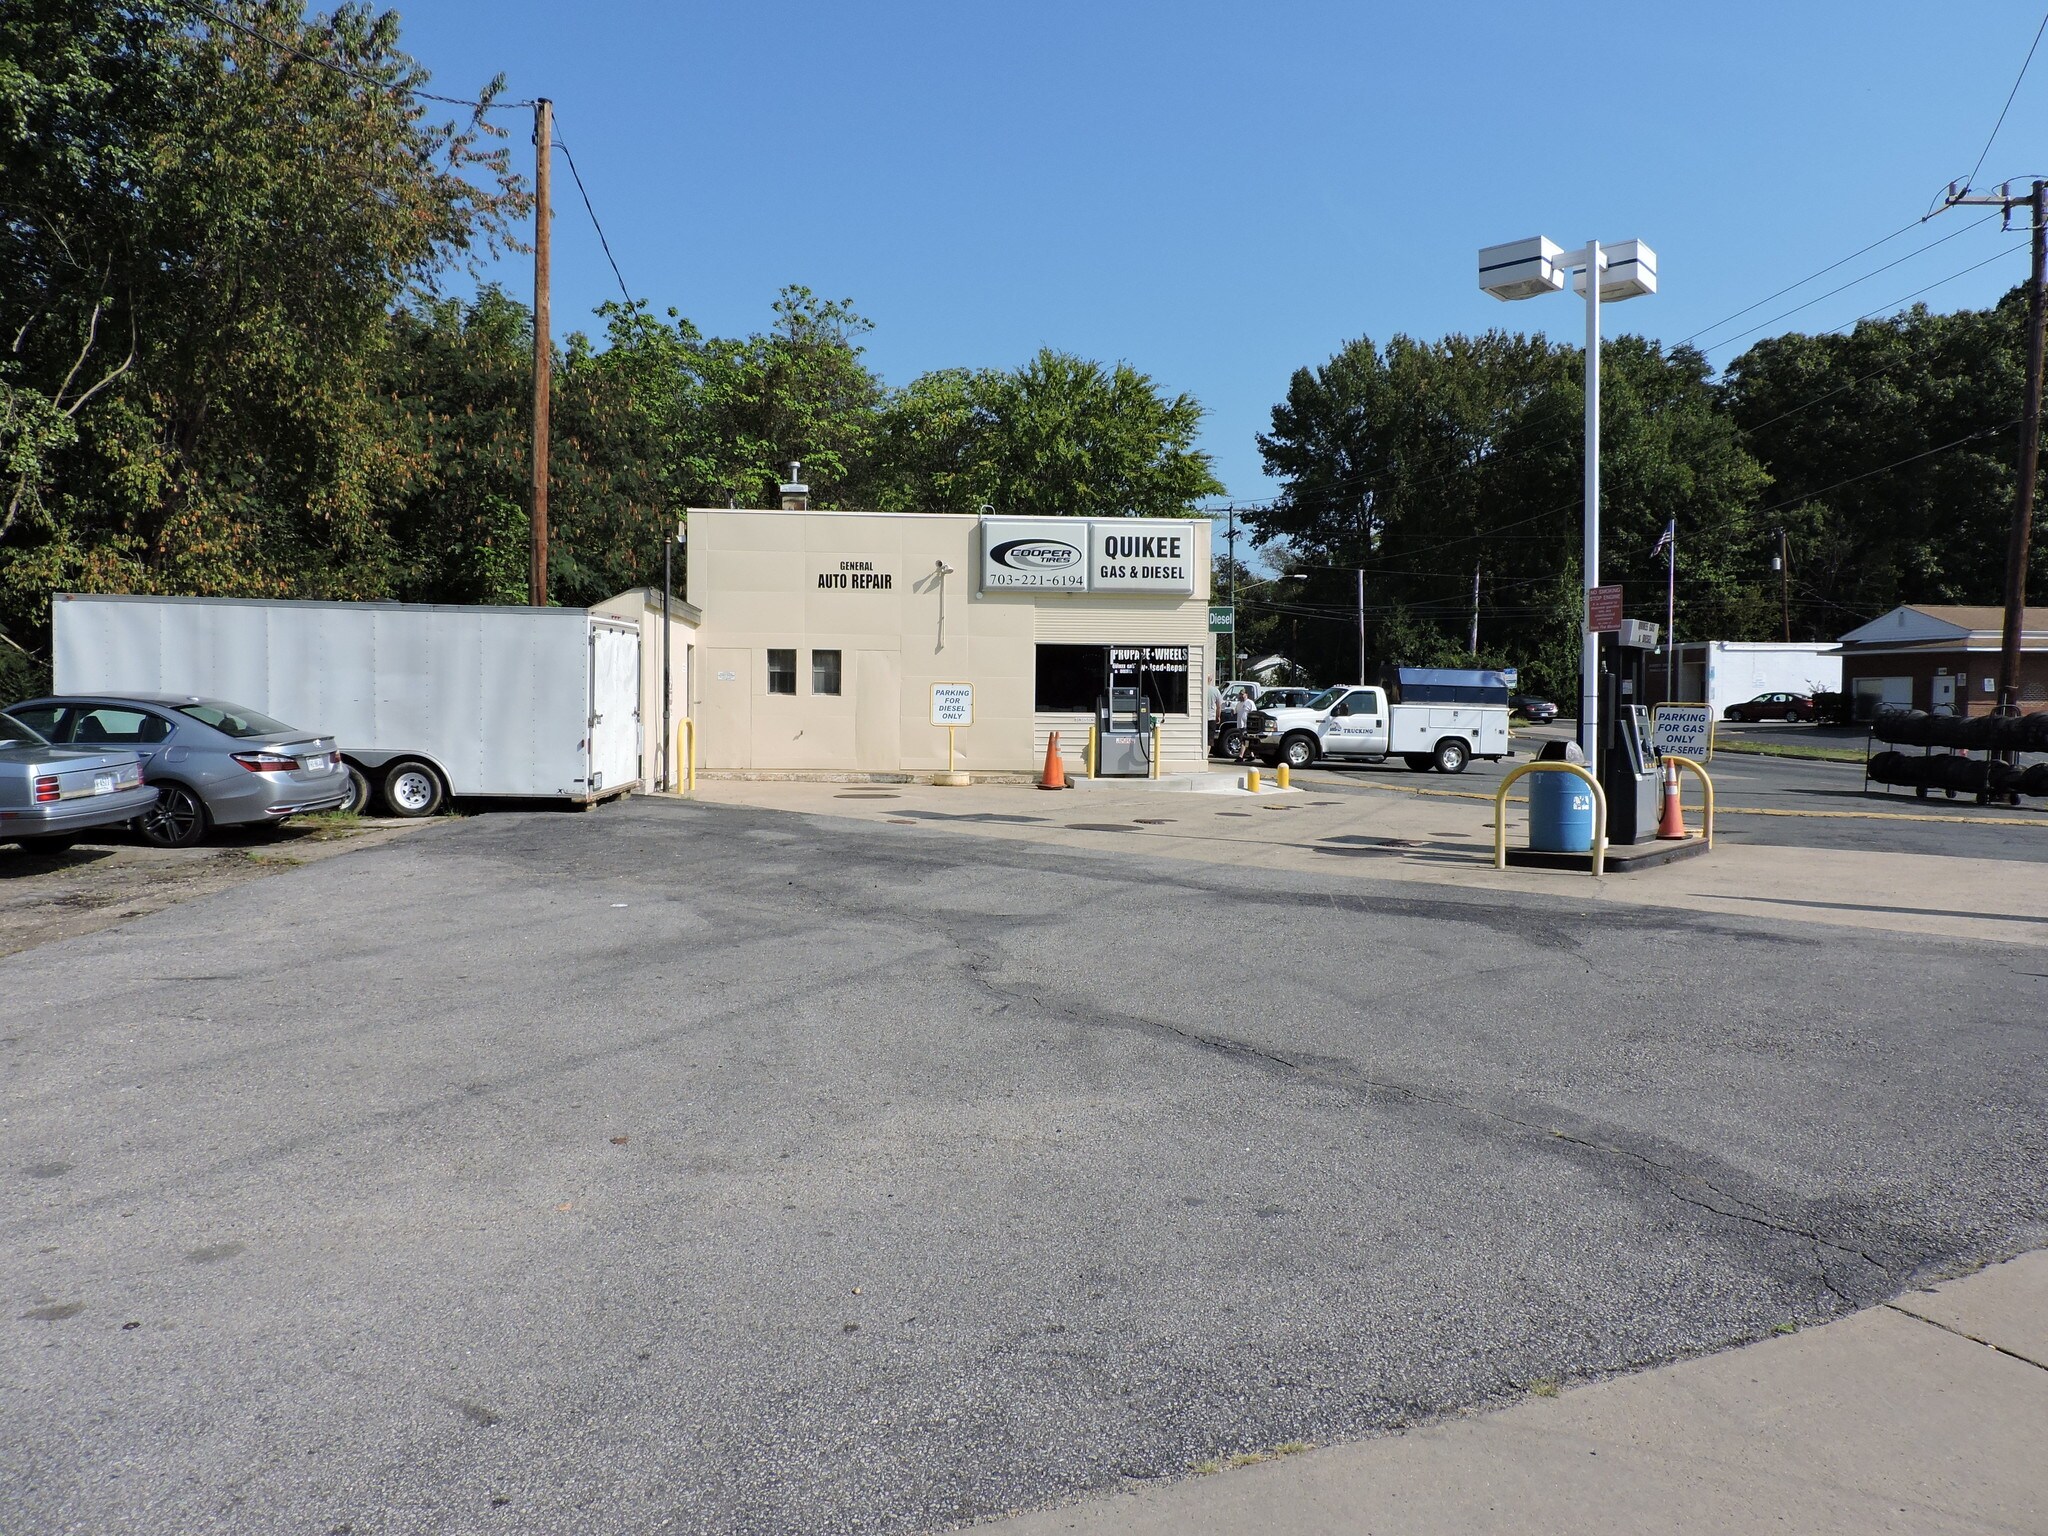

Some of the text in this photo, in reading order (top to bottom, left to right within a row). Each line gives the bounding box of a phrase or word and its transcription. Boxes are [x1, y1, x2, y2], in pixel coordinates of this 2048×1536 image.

[1010, 549, 1072, 557] COOPER
[1105, 536, 1181, 560] QUIKEE
[840, 561, 873, 571] GENERAL
[1100, 565, 1185, 579] GAS & DIESEL
[818, 573, 892, 589] AUTO REPAIR
[990, 574, 1084, 586] 703-221-6194
[1209, 612, 1232, 625] Diesel
[1154, 648, 1188, 661] WHEELS
[935, 689, 970, 697] PARKING
[1658, 713, 1706, 722] PARKING
[1657, 723, 1705, 733] FOR GAS
[1666, 734, 1695, 744] ONLY
